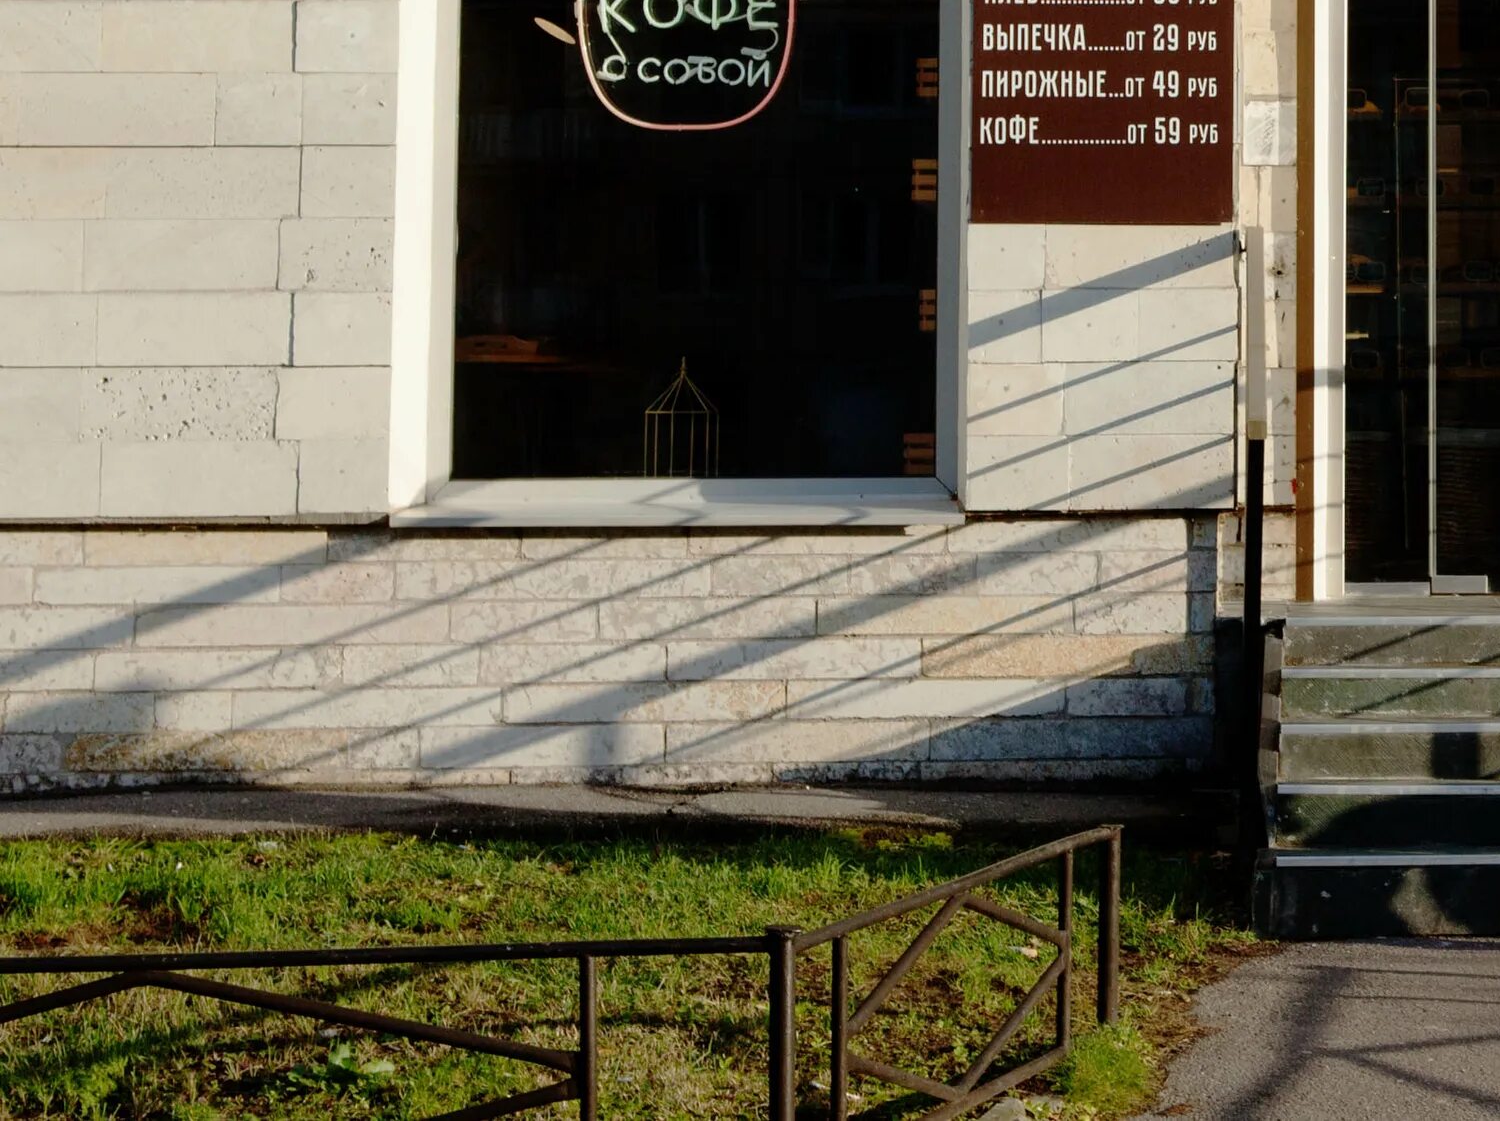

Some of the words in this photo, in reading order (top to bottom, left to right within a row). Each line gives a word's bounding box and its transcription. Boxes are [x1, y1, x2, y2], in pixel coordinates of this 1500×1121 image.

[982, 23, 1087, 51] ВЫПЕЧКА
[1153, 23, 1179, 52] 29
[1187, 30, 1217, 51] РУБ
[981, 70, 1107, 98] ПИРОЖНЫЕ
[1152, 70, 1180, 98] 49
[1187, 77, 1218, 98] РУБ
[1154, 116, 1181, 145] 59
[1189, 123, 1219, 144] РУБ
